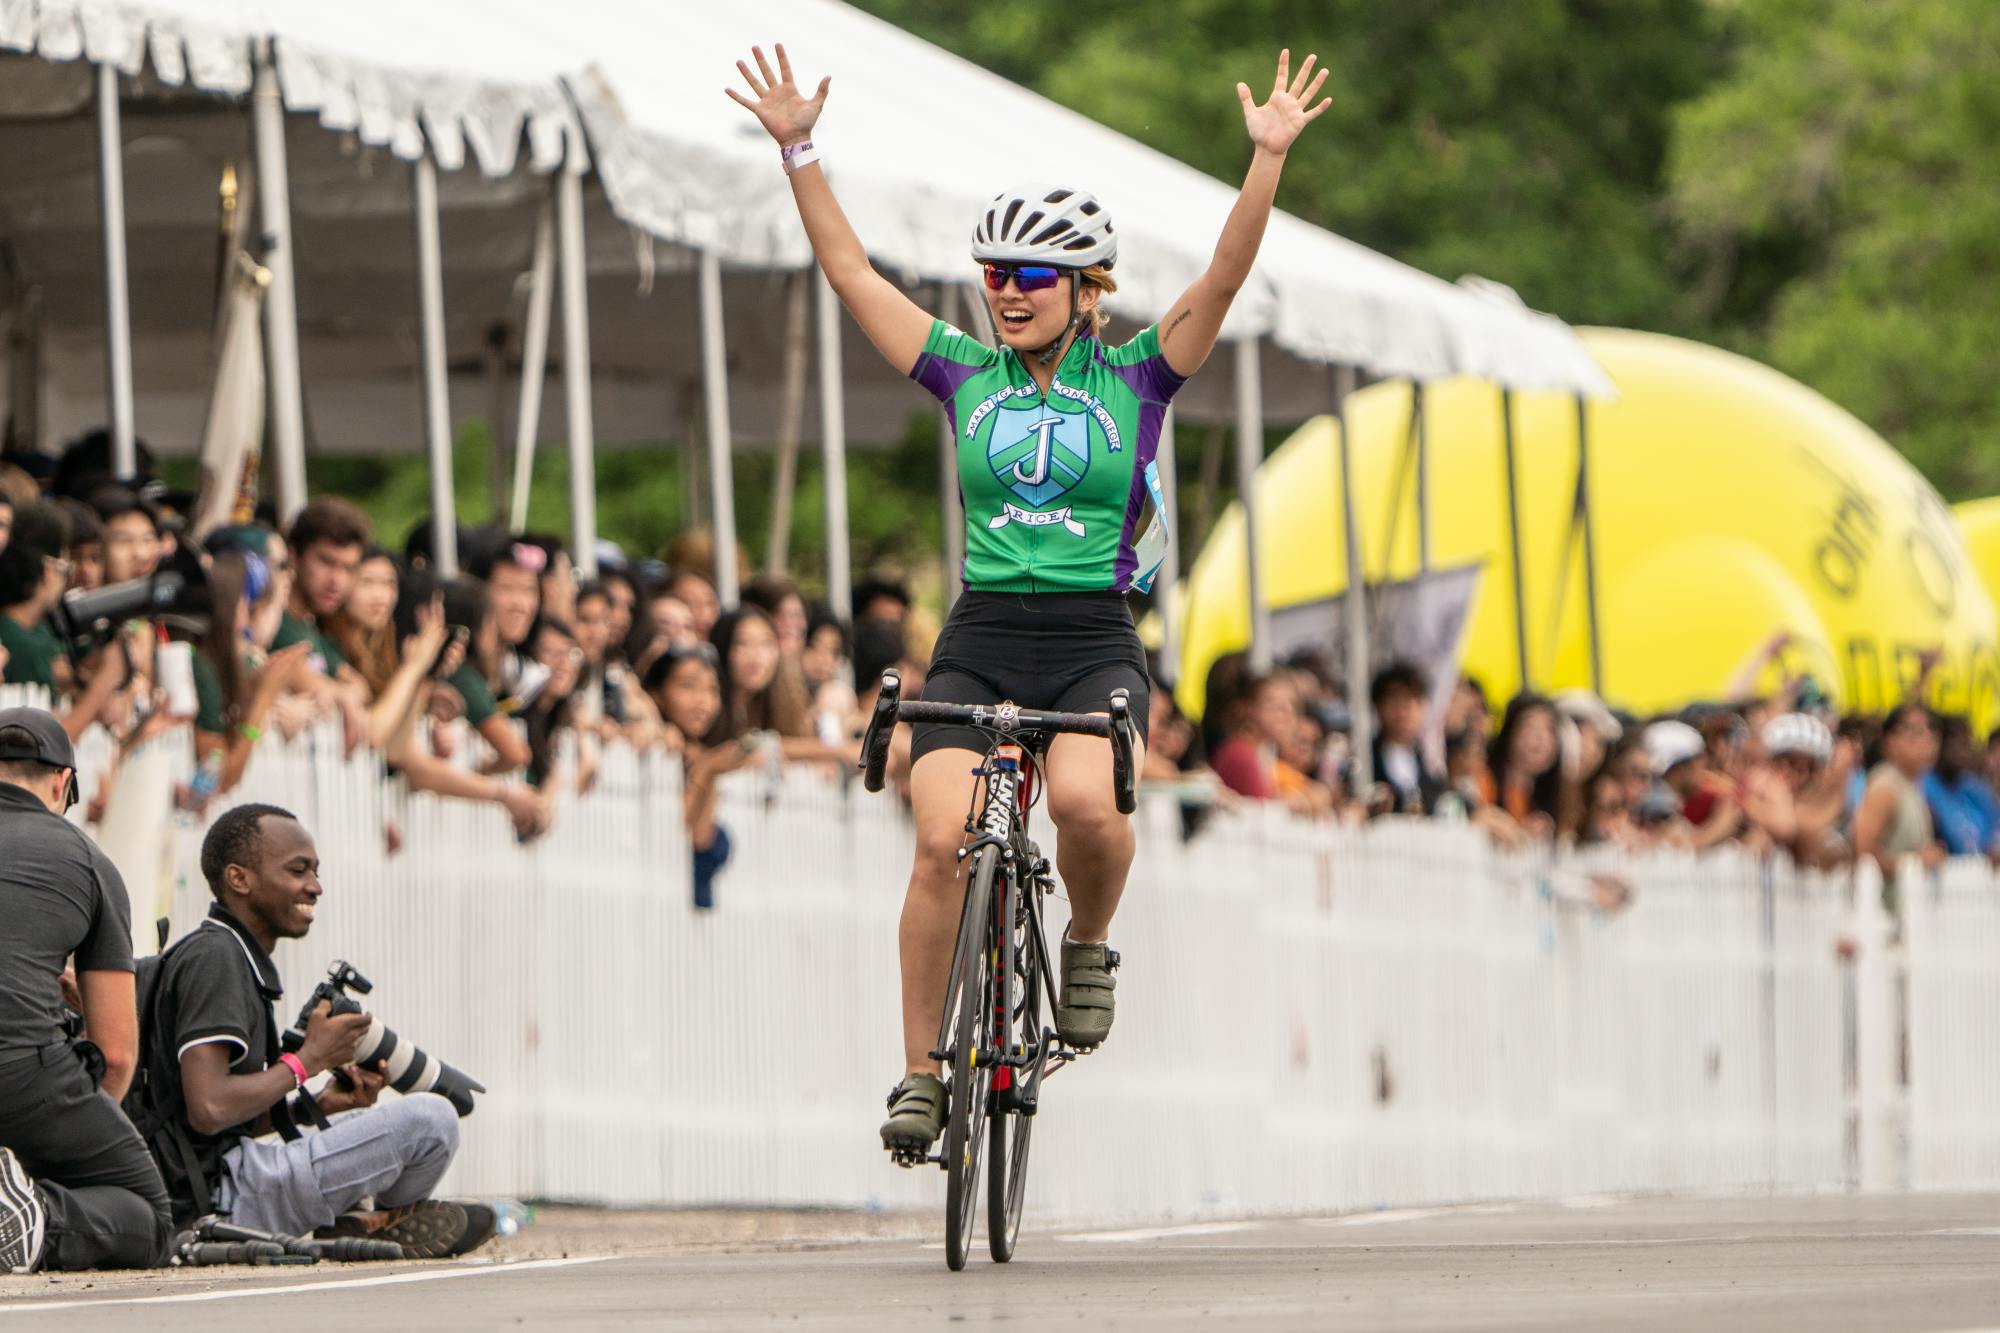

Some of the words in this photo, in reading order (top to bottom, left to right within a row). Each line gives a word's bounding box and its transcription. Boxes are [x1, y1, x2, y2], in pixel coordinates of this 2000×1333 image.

[970, 402, 991, 431] MARY
[1012, 417, 1065, 487] J
[1013, 509, 1060, 523] RICE
[998, 773, 1013, 840] GIANT
